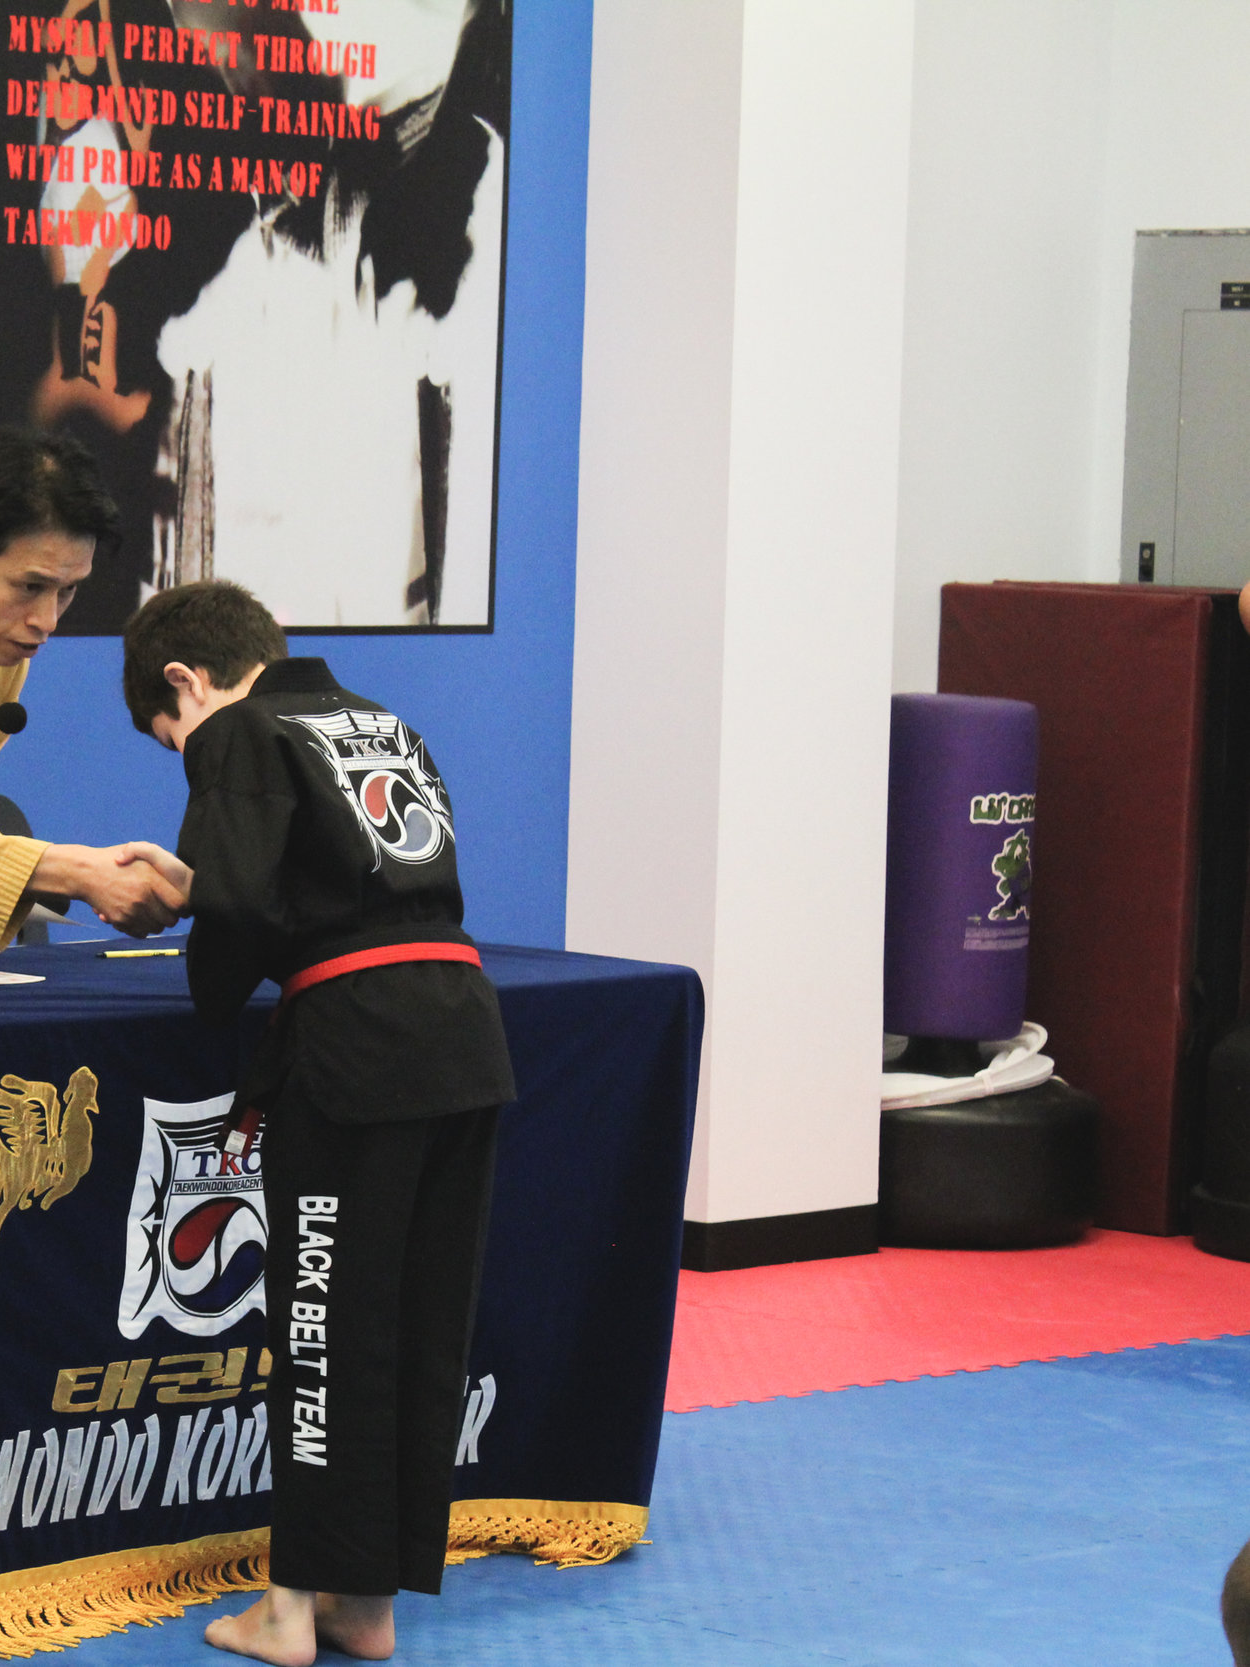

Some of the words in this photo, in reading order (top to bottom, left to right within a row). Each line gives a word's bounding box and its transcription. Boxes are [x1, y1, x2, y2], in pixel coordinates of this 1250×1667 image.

[8, 15, 112, 58] MYSELF
[124, 22, 241, 69] PERFECT
[253, 34, 377, 80] THROUGH
[6, 78, 177, 126] DETERMINED
[6, 143, 75, 183] WITH
[82, 146, 163, 188] PRIDE
[169, 153, 201, 189] AS
[208, 156, 223, 191] A
[230, 156, 284, 195] MAN
[289, 161, 323, 198] OF
[4, 207, 172, 251] TAEKWONDO
[343, 737, 392, 758] TKC
[296, 1195, 339, 1294] BLACK
[289, 1301, 328, 1377] BELT
[292, 1386, 328, 1467] TEAM
